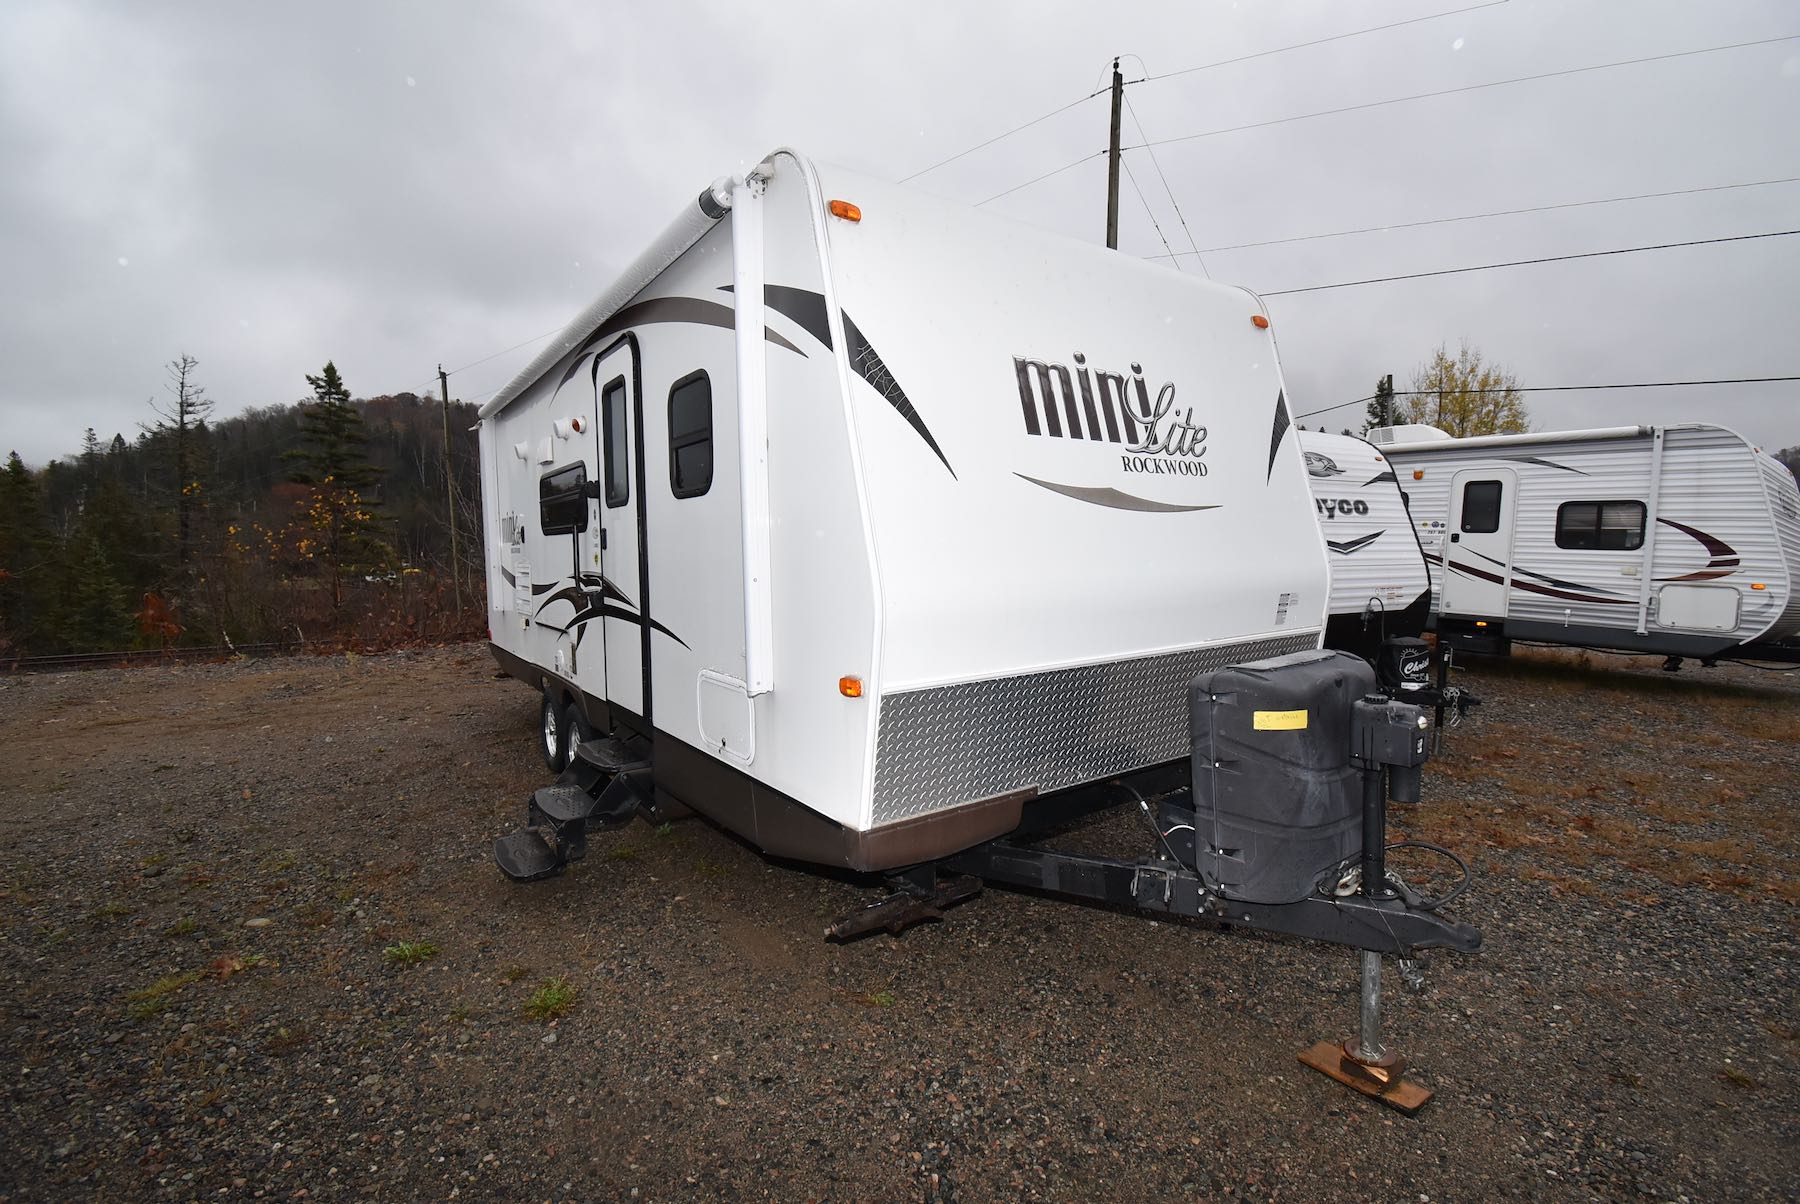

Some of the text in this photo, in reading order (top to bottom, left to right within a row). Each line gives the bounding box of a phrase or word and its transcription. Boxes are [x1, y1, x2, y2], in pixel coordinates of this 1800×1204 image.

[1011, 350, 1159, 445] mini
[1122, 374, 1208, 458] Lite
[1120, 455, 1208, 477] ROCKWOOD
